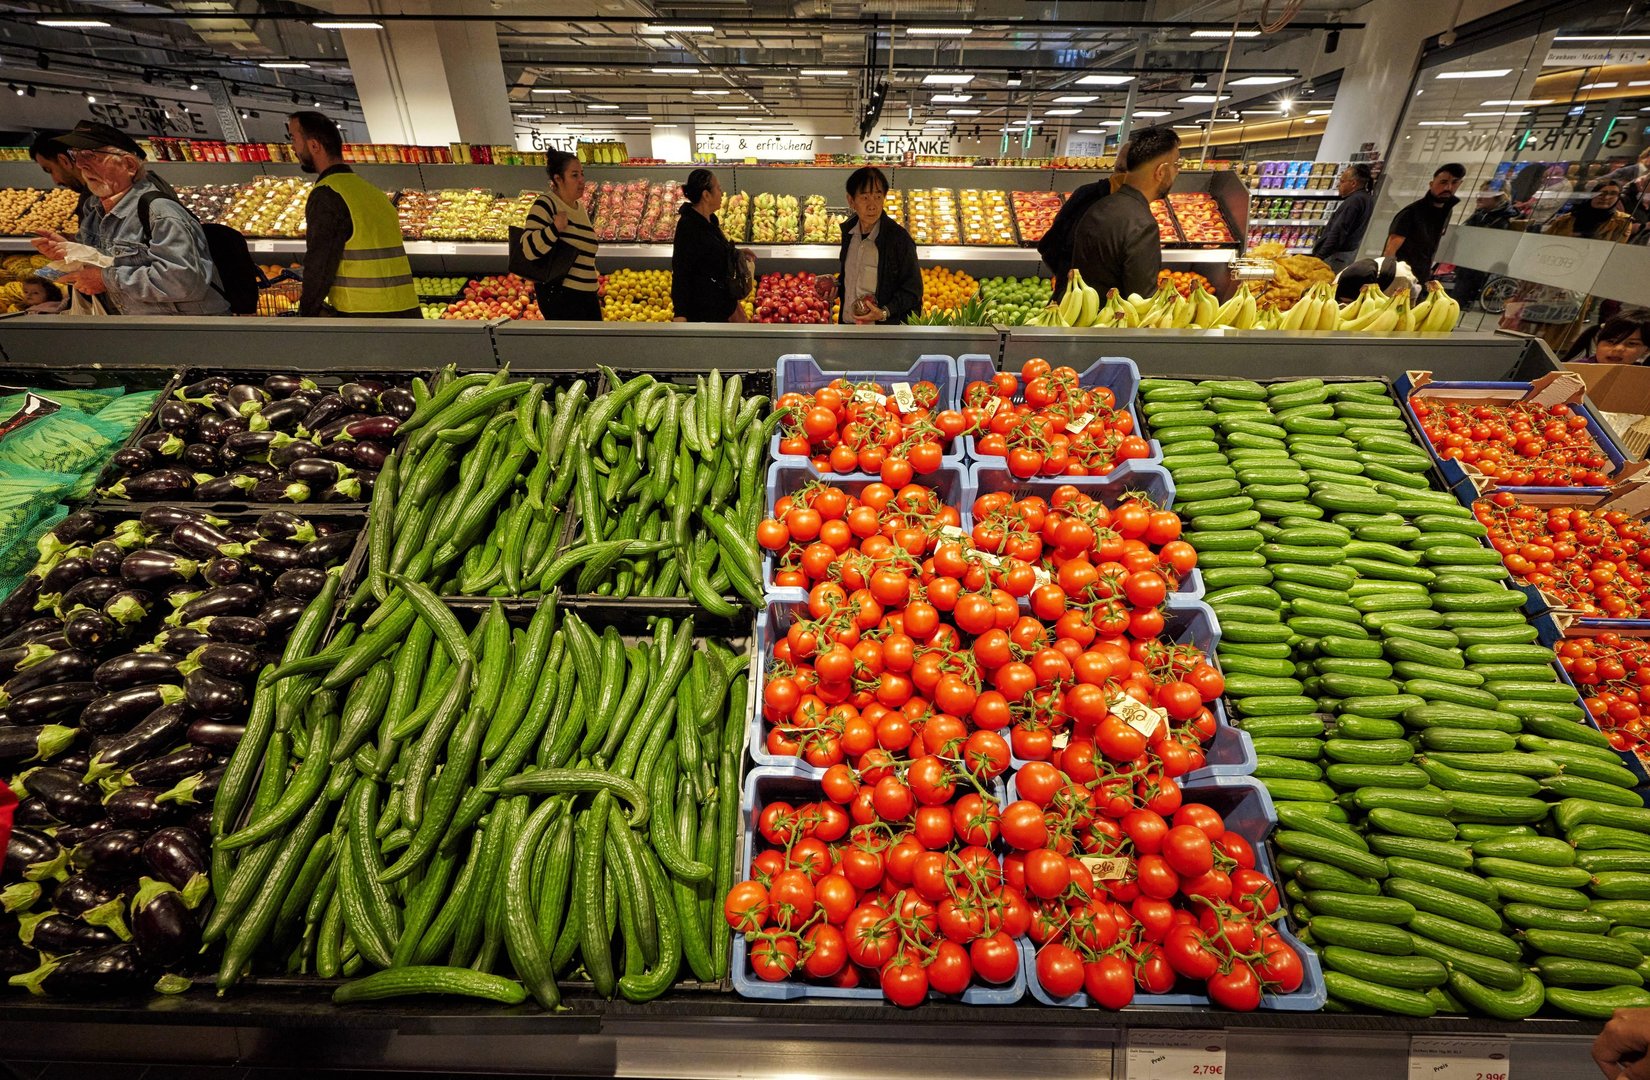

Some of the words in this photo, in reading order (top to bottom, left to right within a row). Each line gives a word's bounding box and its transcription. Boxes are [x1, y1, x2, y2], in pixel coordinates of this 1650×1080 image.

[532, 136, 616, 151] GETR
[696, 140, 730, 153] pritzig
[738, 138, 748, 150] &
[756, 138, 813, 151] erfrischend
[864, 139, 950, 154] GETRÄNKE
[1151, 1055, 1166, 1065] Preis
[1193, 1065, 1223, 1075] 2,79€
[1433, 1063, 1449, 1072] Preis
[1476, 1072, 1507, 1080] 299€
